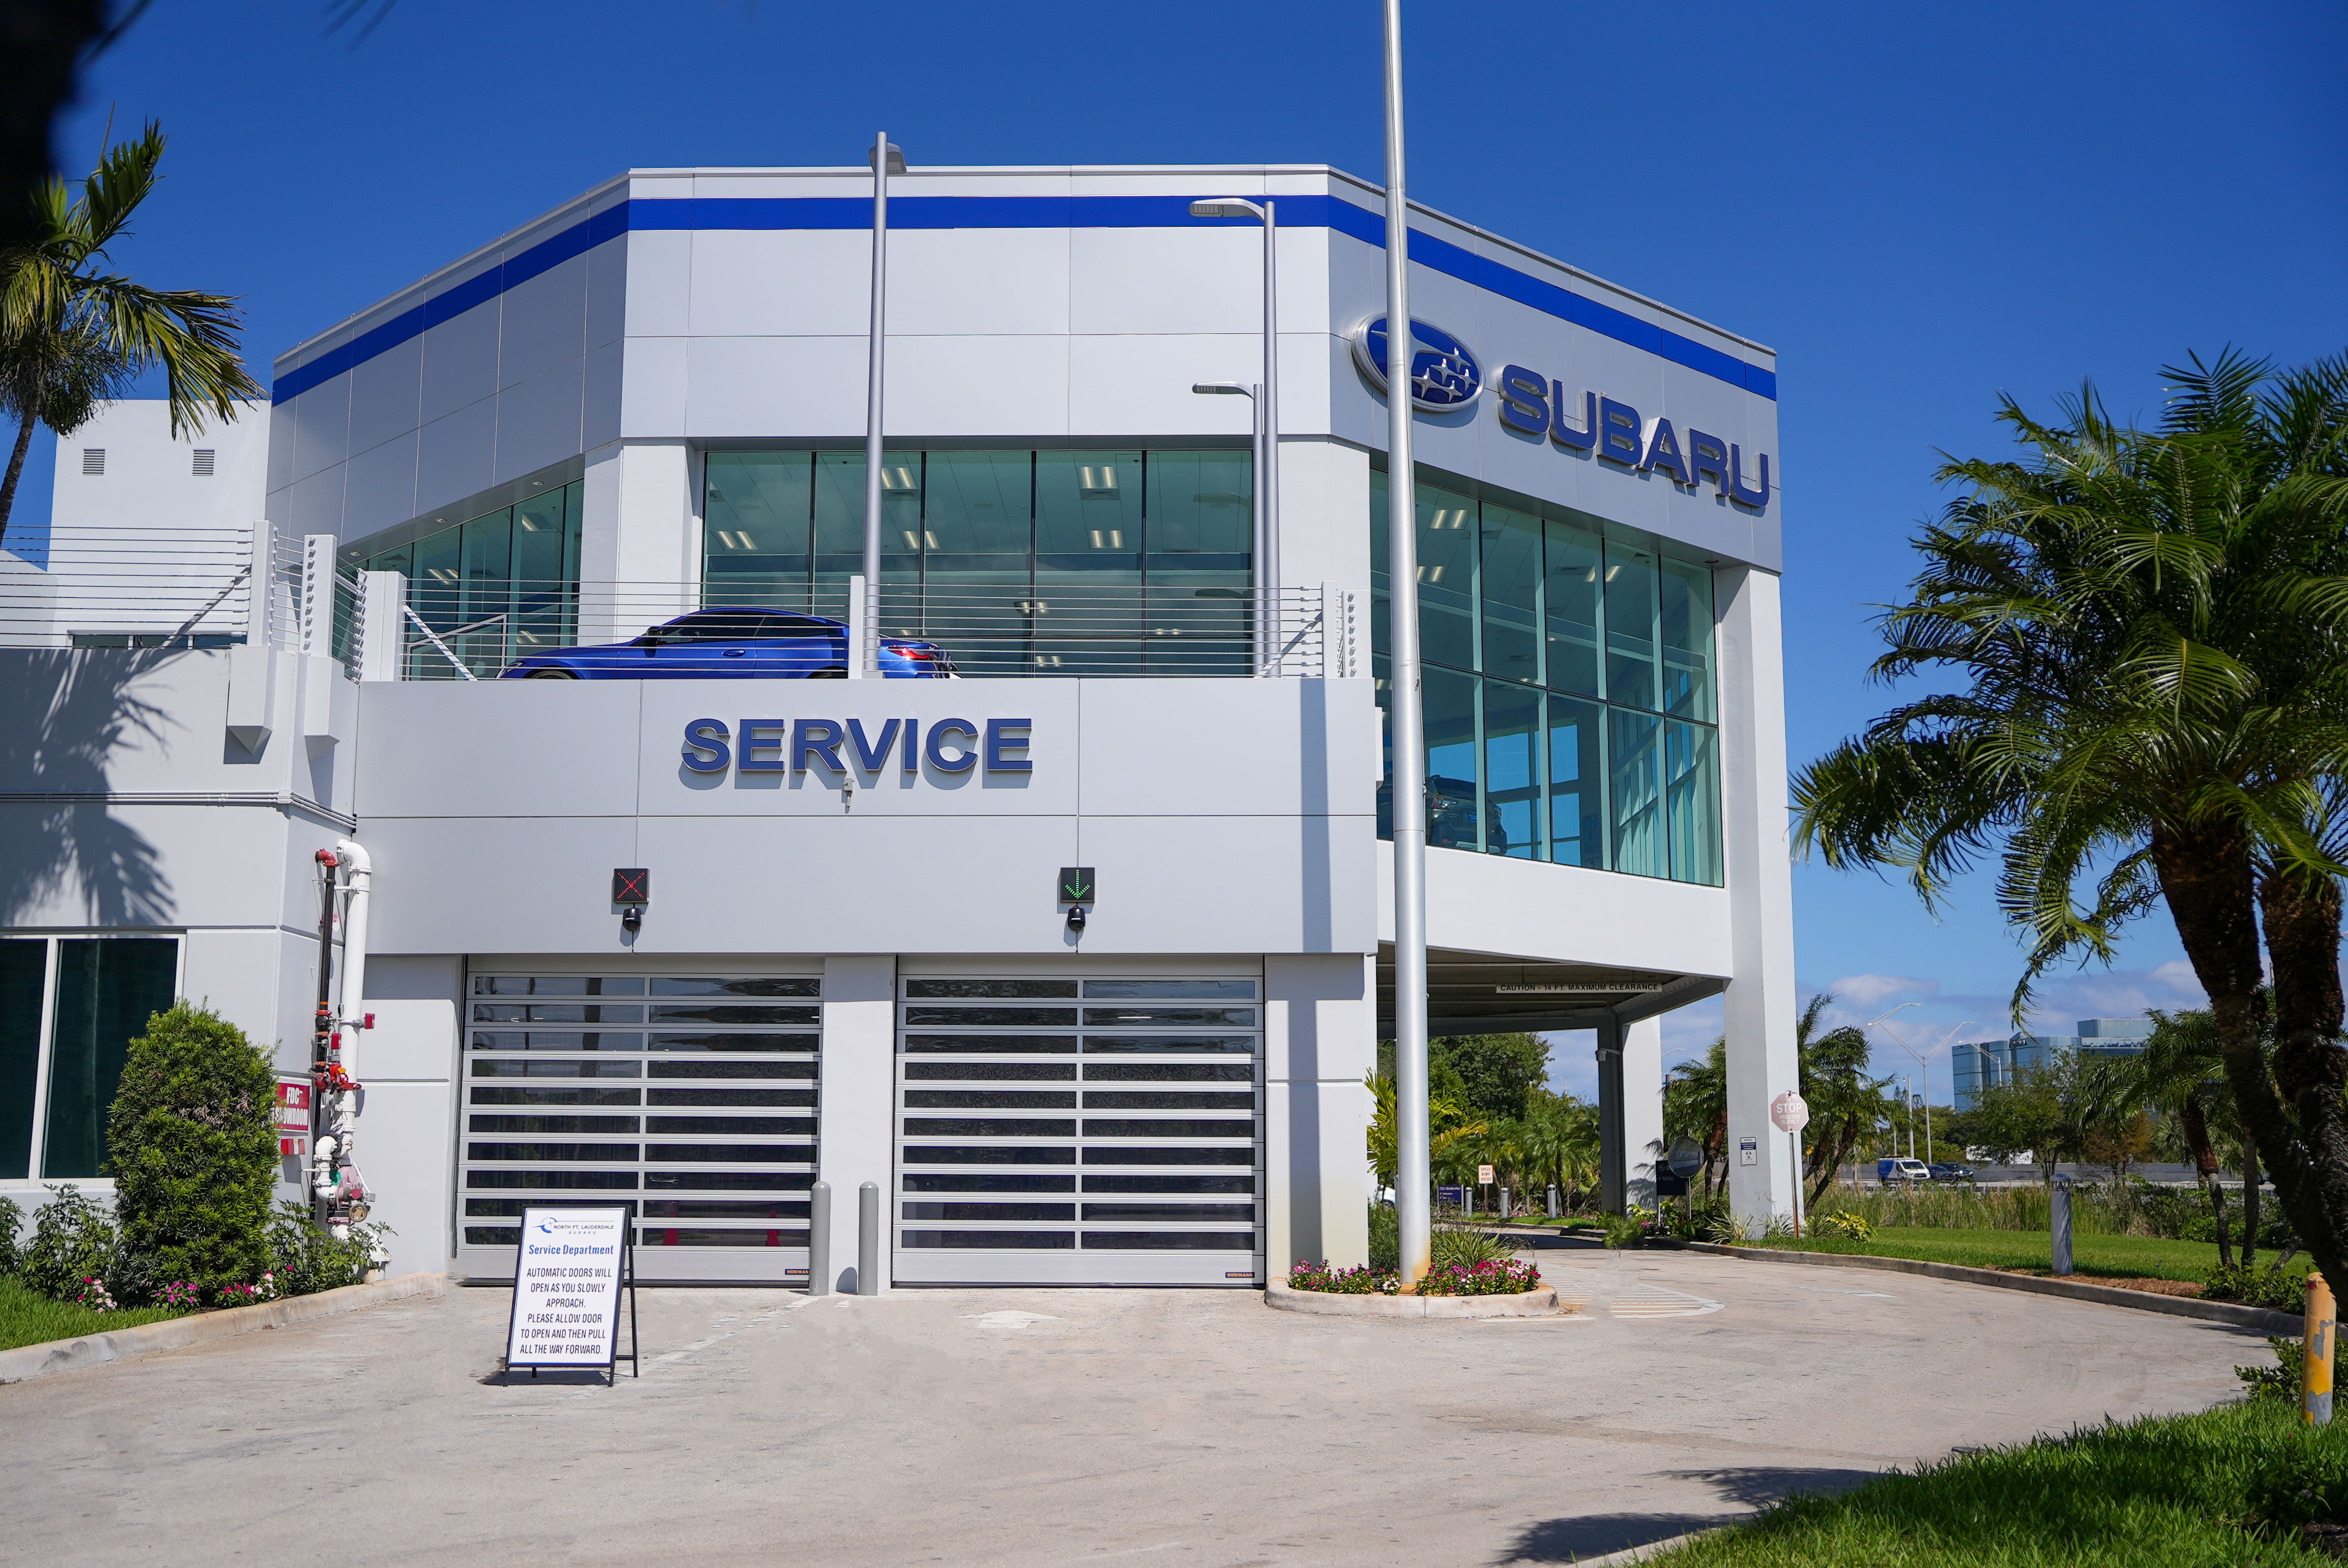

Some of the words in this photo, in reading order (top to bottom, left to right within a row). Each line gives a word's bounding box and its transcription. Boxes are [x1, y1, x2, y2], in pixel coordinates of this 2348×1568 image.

[1497, 364, 1770, 508] SUBARU
[681, 718, 1033, 772] SERVICE
[1777, 1103, 1801, 1113] STOP
[529, 1244, 561, 1255] Service
[563, 1245, 614, 1256] Department
[527, 1268, 567, 1277] AUTOMATIC
[569, 1268, 593, 1277] DOORS
[595, 1268, 611, 1277] WILL
[531, 1283, 549, 1292] OPEN
[550, 1283, 560, 1292] AS
[562, 1283, 575, 1292] YOU
[577, 1283, 606, 1293] SLOWLY
[545, 1298, 586, 1308] APPROACH.
[527, 1313, 554, 1323] PLEASE
[555, 1313, 581, 1323] ALLOW
[582, 1313, 603, 1323] DOOR
[521, 1329, 529, 1338] TO
[531, 1329, 550, 1338] OPEN
[552, 1329, 567, 1338] AND
[568, 1329, 586, 1339] THEN
[588, 1329, 606, 1339] PULL
[519, 1344, 533, 1354] ALL
[534, 1344, 548, 1354] THE
[549, 1344, 564, 1354] WAY
[565, 1344, 603, 1354] FORWARD.
